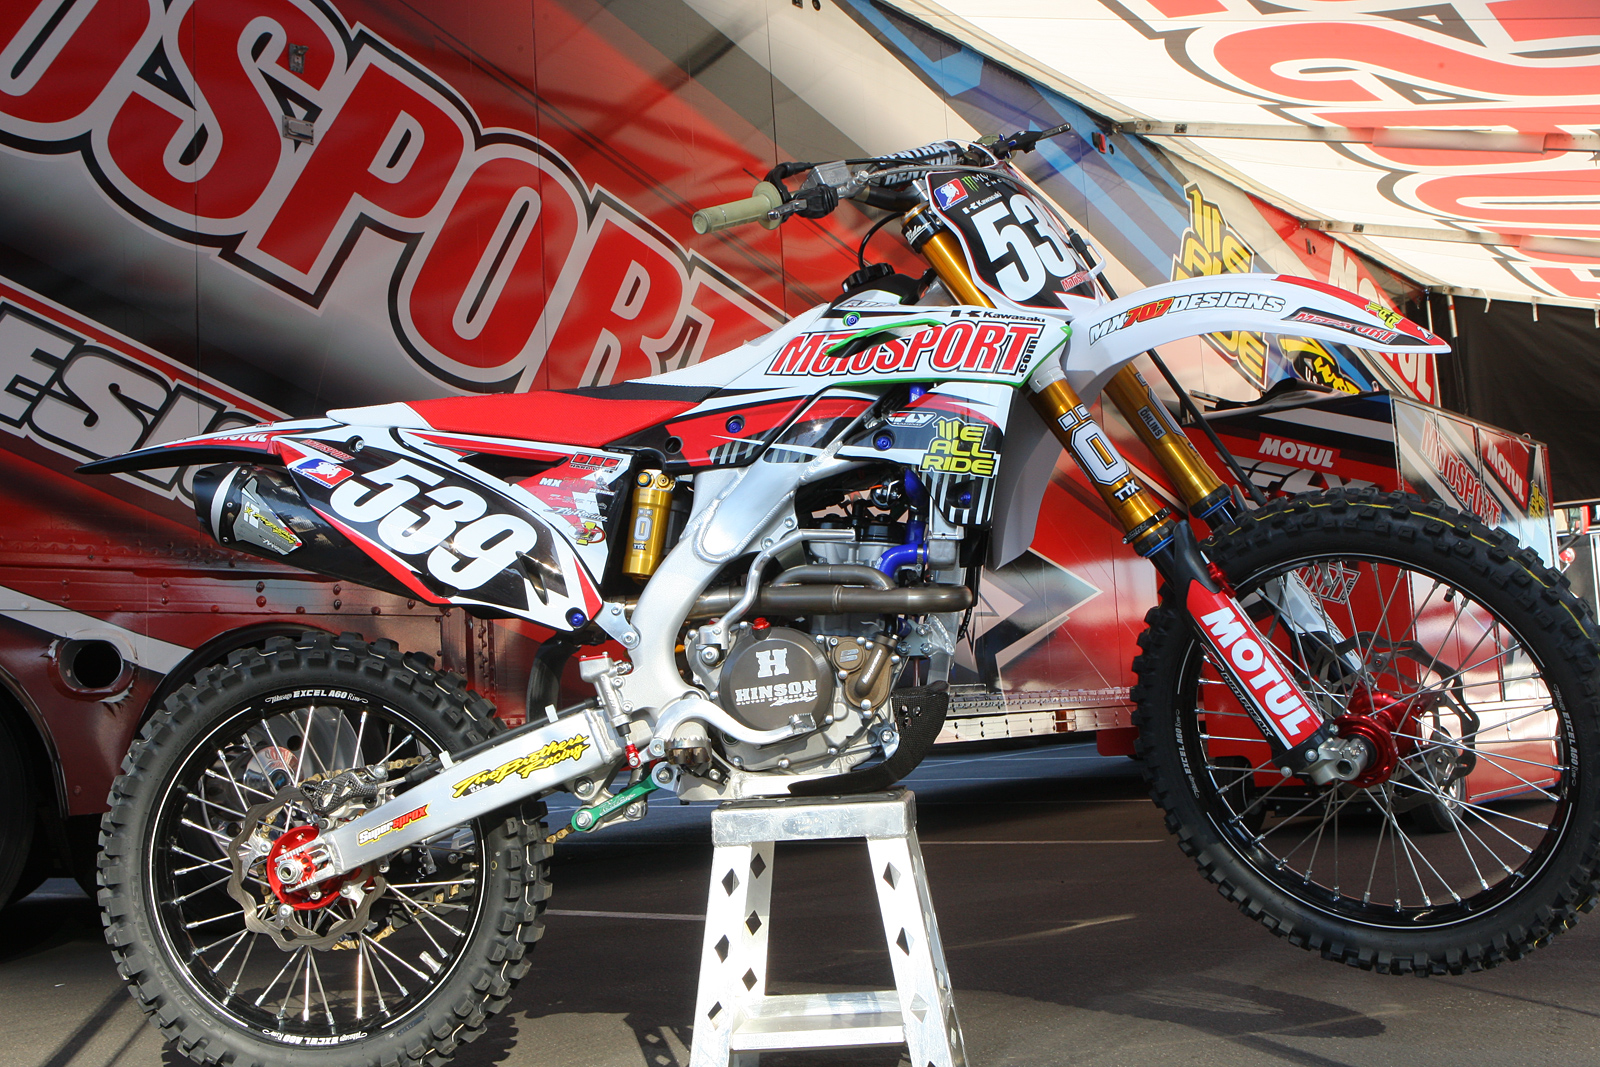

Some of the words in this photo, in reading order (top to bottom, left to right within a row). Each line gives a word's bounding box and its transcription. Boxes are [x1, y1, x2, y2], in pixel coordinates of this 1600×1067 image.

[983, 311, 1045, 323] Kawasaki
[572, 453, 621, 468] DRC
[929, 439, 993, 459] ALL
[1258, 437, 1334, 468] MOTUL
[921, 454, 995, 475] RIDE
[1487, 439, 1525, 503] MOTUL
[1114, 479, 1141, 501] TTX
[330, 458, 537, 590] 539
[1200, 606, 1311, 736] MOTUL
[293, 690, 327, 698] EXCEL
[328, 691, 348, 699] A60
[735, 679, 817, 702] HINSON
[1562, 711, 1576, 745] EXCEL
[1569, 746, 1578, 766] A60
[518, 744, 590, 778] Racing
[1178, 745, 1192, 775] EXCEL
[304, 1036, 339, 1046] EXCEL
